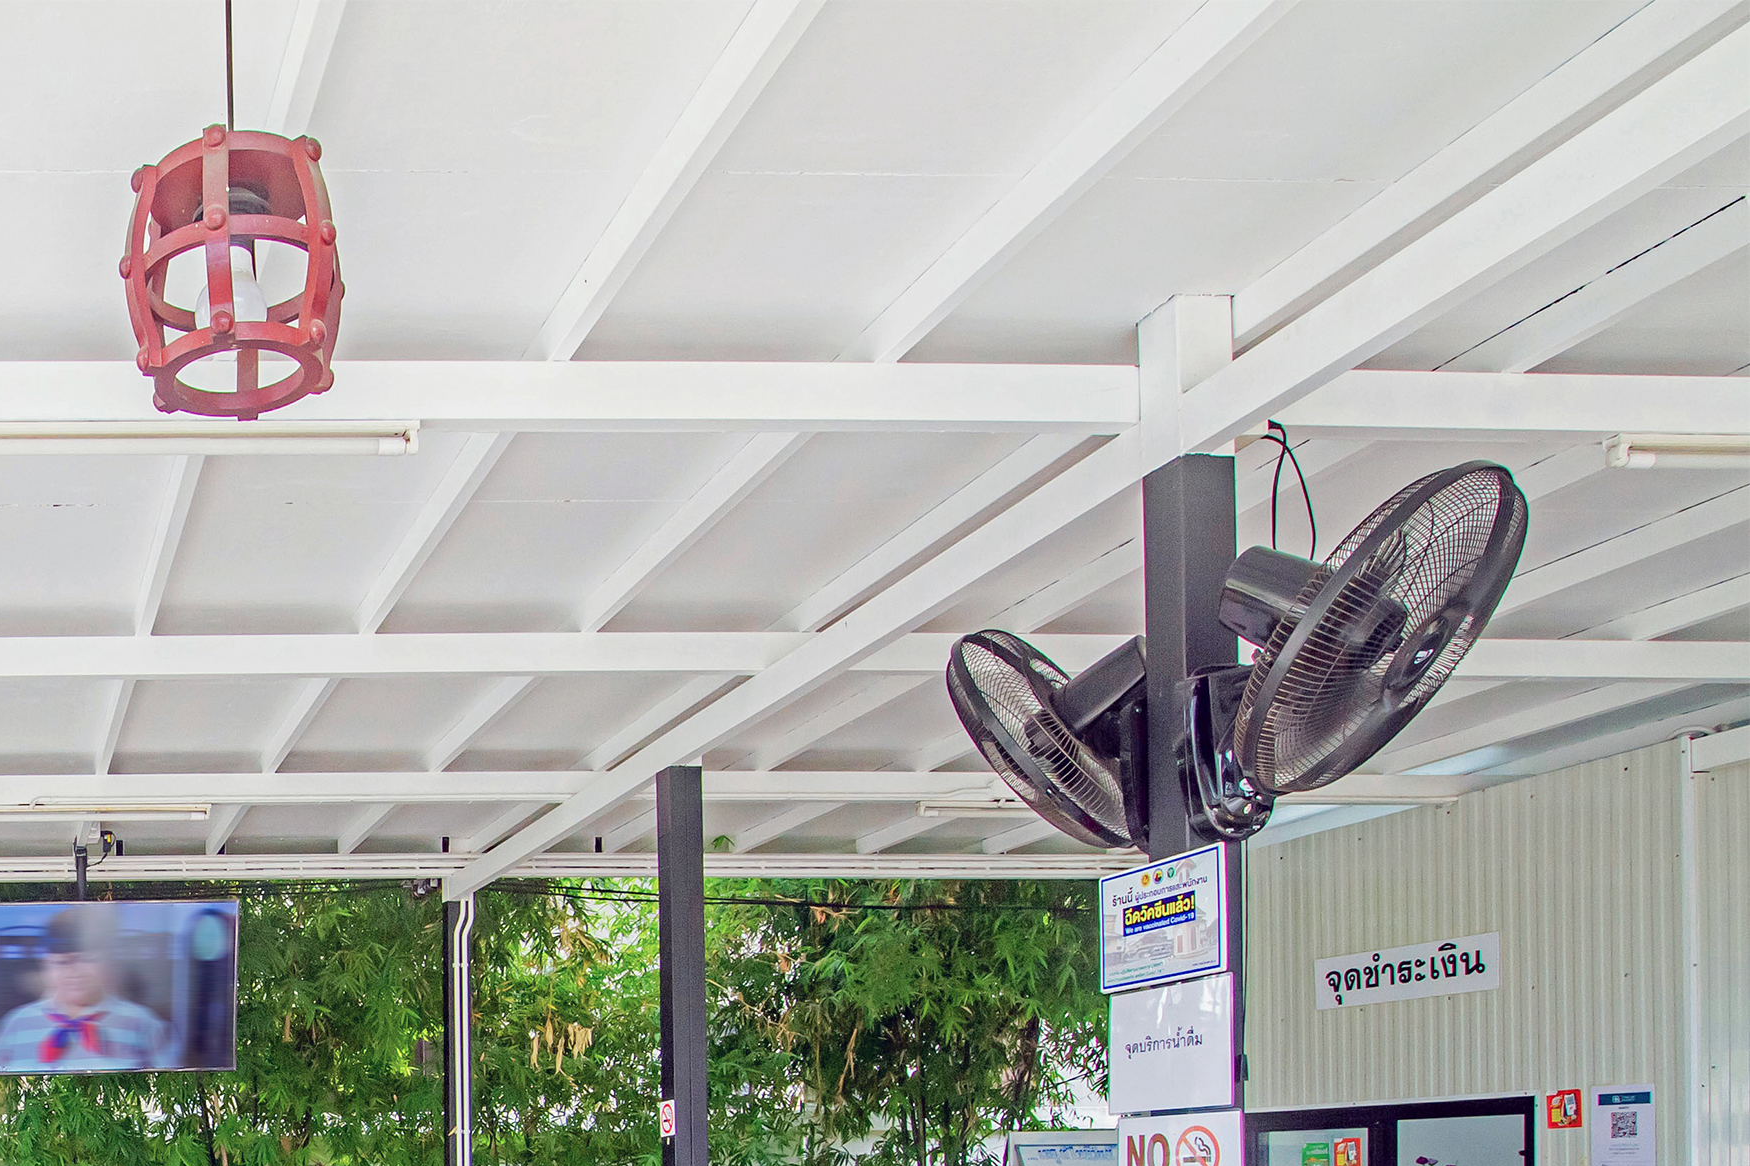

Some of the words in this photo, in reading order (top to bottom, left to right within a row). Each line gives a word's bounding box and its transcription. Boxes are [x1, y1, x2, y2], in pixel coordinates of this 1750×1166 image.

[1111, 886, 1133, 908] ร้านนี้
[1124, 894, 1195, 926] ฉีดวัคซีนแล้ว!
[1325, 942, 1487, 1006] จุดชำระเงิน
[1124, 1026, 1203, 1059] จุดบริการน้ำดื่ม
